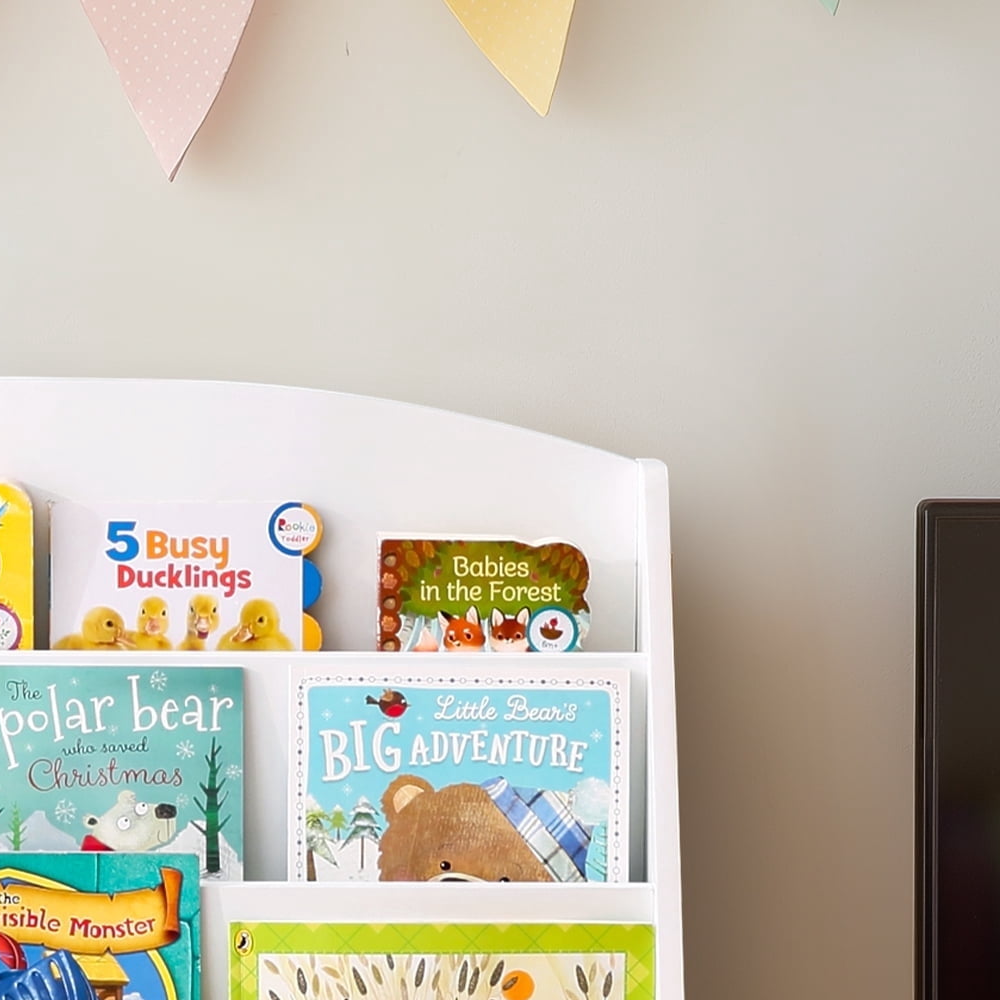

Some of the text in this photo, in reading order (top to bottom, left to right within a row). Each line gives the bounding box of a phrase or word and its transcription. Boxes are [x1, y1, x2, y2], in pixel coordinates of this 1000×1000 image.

[105, 521, 229, 569] 5 Busy
[452, 555, 529, 578] Babies
[117, 564, 252, 597] Ducklings
[420, 580, 561, 602] in the Forest
[6, 680, 42, 702] The
[127, 674, 234, 733] bear
[434, 694, 577, 721] Little Bear's
[62, 737, 149, 756] who saved
[319, 720, 588, 782] BIG ADVENTURE
[27, 758, 183, 792] Christmas
[69, 916, 156, 939] Monster
